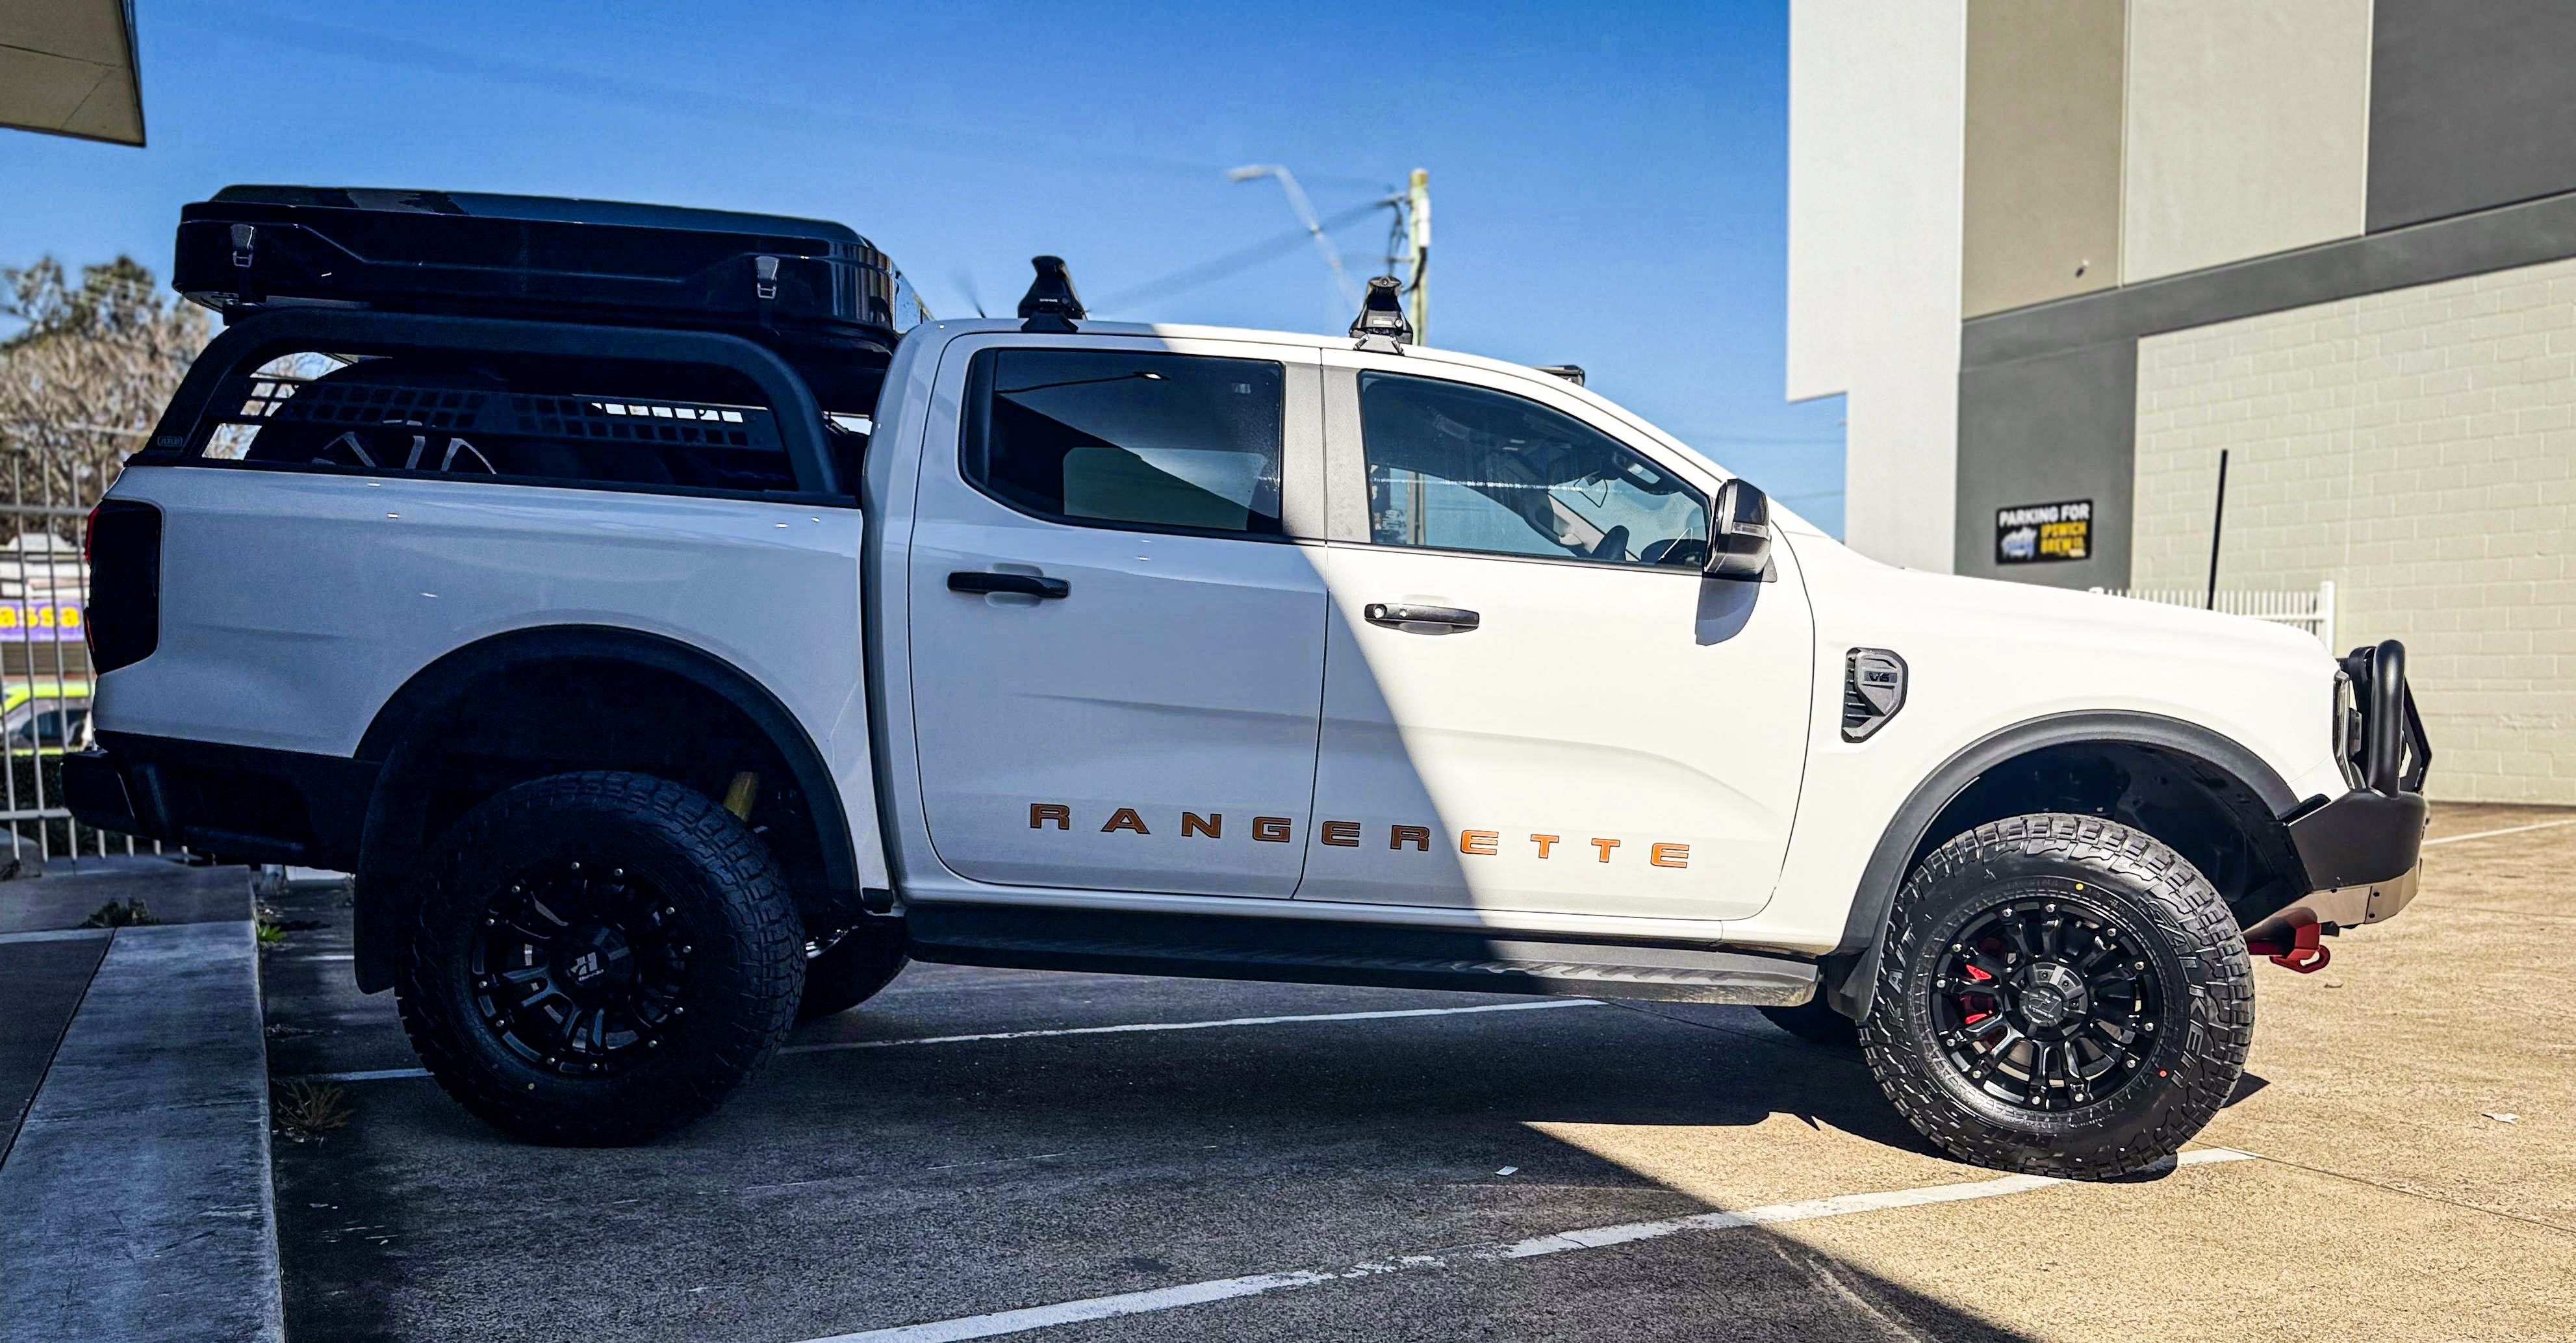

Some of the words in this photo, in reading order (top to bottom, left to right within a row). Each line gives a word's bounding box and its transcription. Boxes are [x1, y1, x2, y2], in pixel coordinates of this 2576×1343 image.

[2000, 507, 2059, 527] PARKING
[2061, 504, 2089, 520] FOR
[1030, 804, 1689, 868] RANGERETTE
